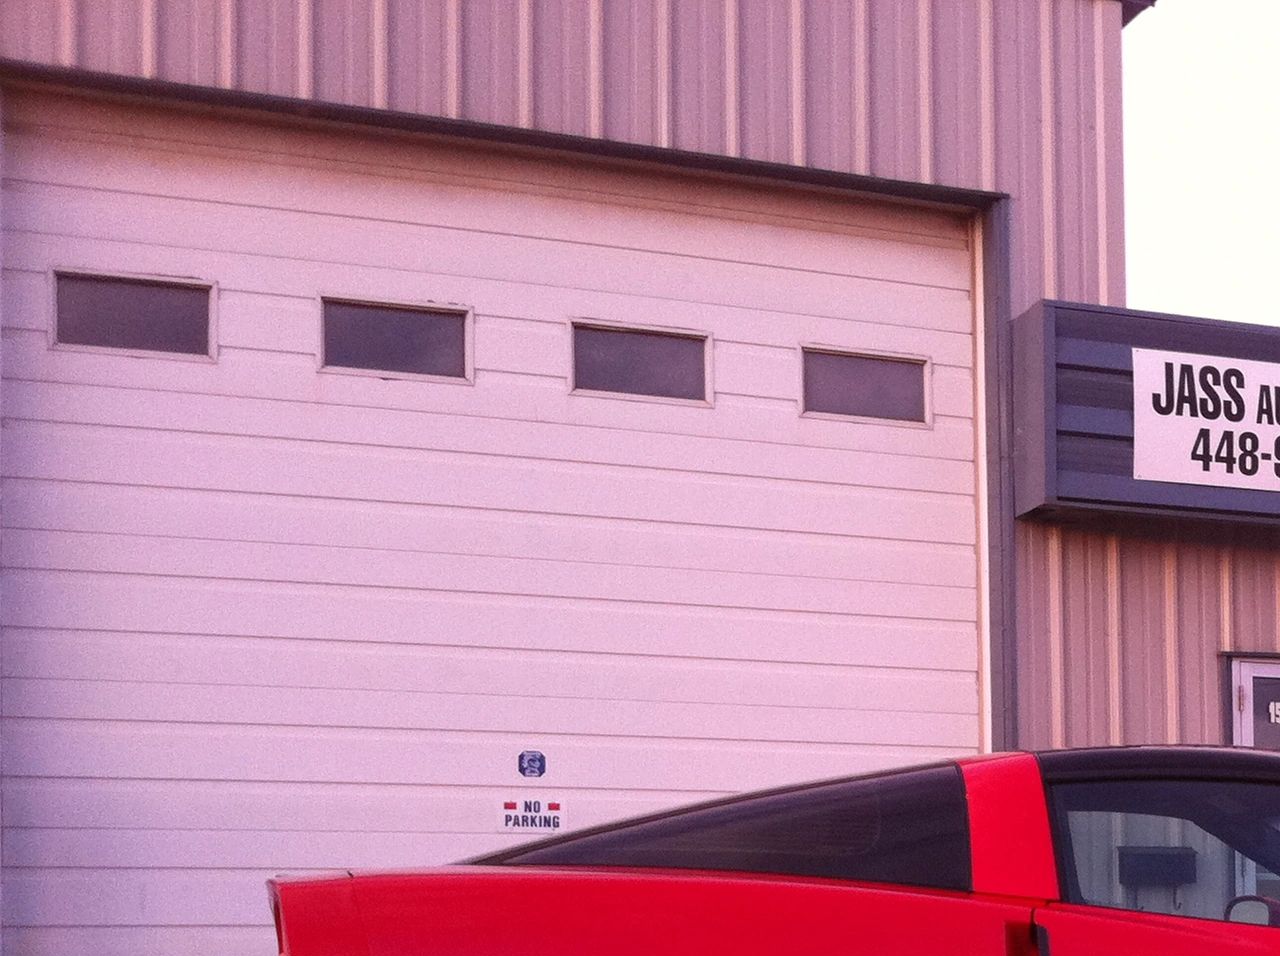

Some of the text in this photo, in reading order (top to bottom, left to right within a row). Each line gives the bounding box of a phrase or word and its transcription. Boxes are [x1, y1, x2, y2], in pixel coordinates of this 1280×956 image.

[1152, 362, 1245, 422] JASS
[524, 800, 541, 813] NO
[504, 814, 560, 828] PARKING
